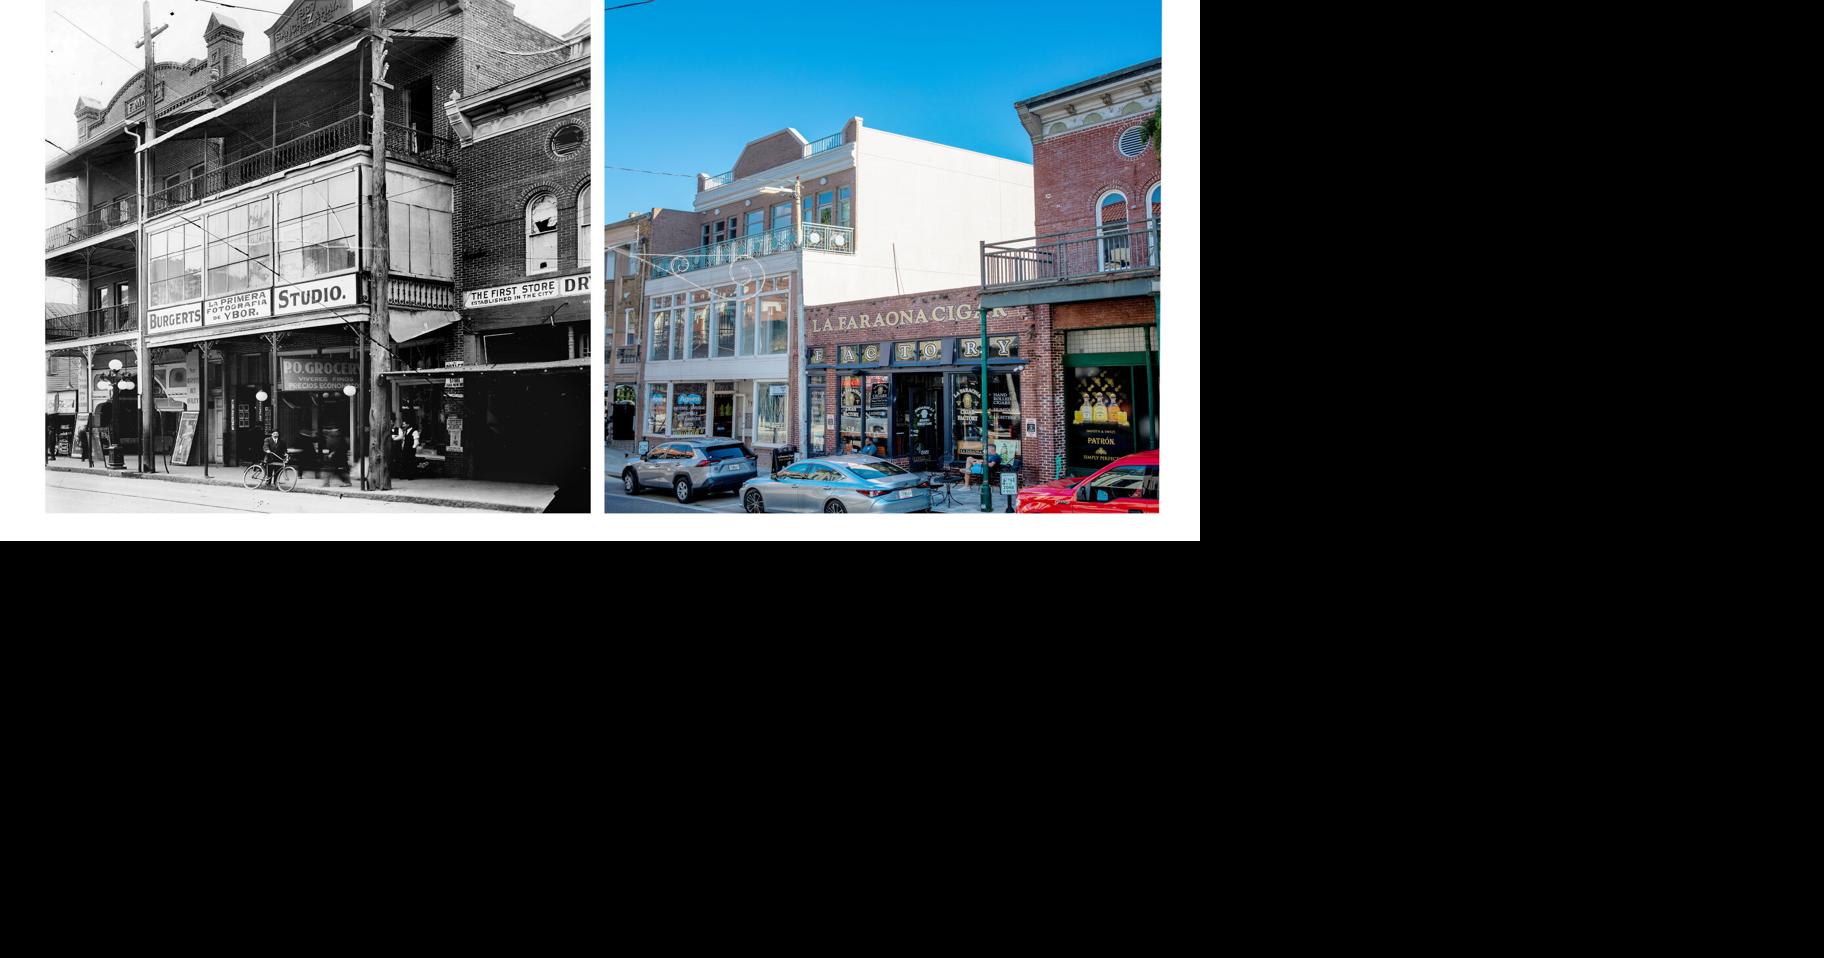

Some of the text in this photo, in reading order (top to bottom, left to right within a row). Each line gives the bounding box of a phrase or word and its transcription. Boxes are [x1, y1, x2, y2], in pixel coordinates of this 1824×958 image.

[472, 281, 555, 300] THE FIRST STORE
[565, 275, 591, 292] DR
[220, 291, 266, 305] PRIMERA
[278, 285, 346, 309] STUDIO.
[471, 296, 512, 306] ESTABLISHED
[149, 309, 201, 329] BURGERTS
[812, 318, 833, 333] LA
[838, 308, 929, 331] FARAONA
